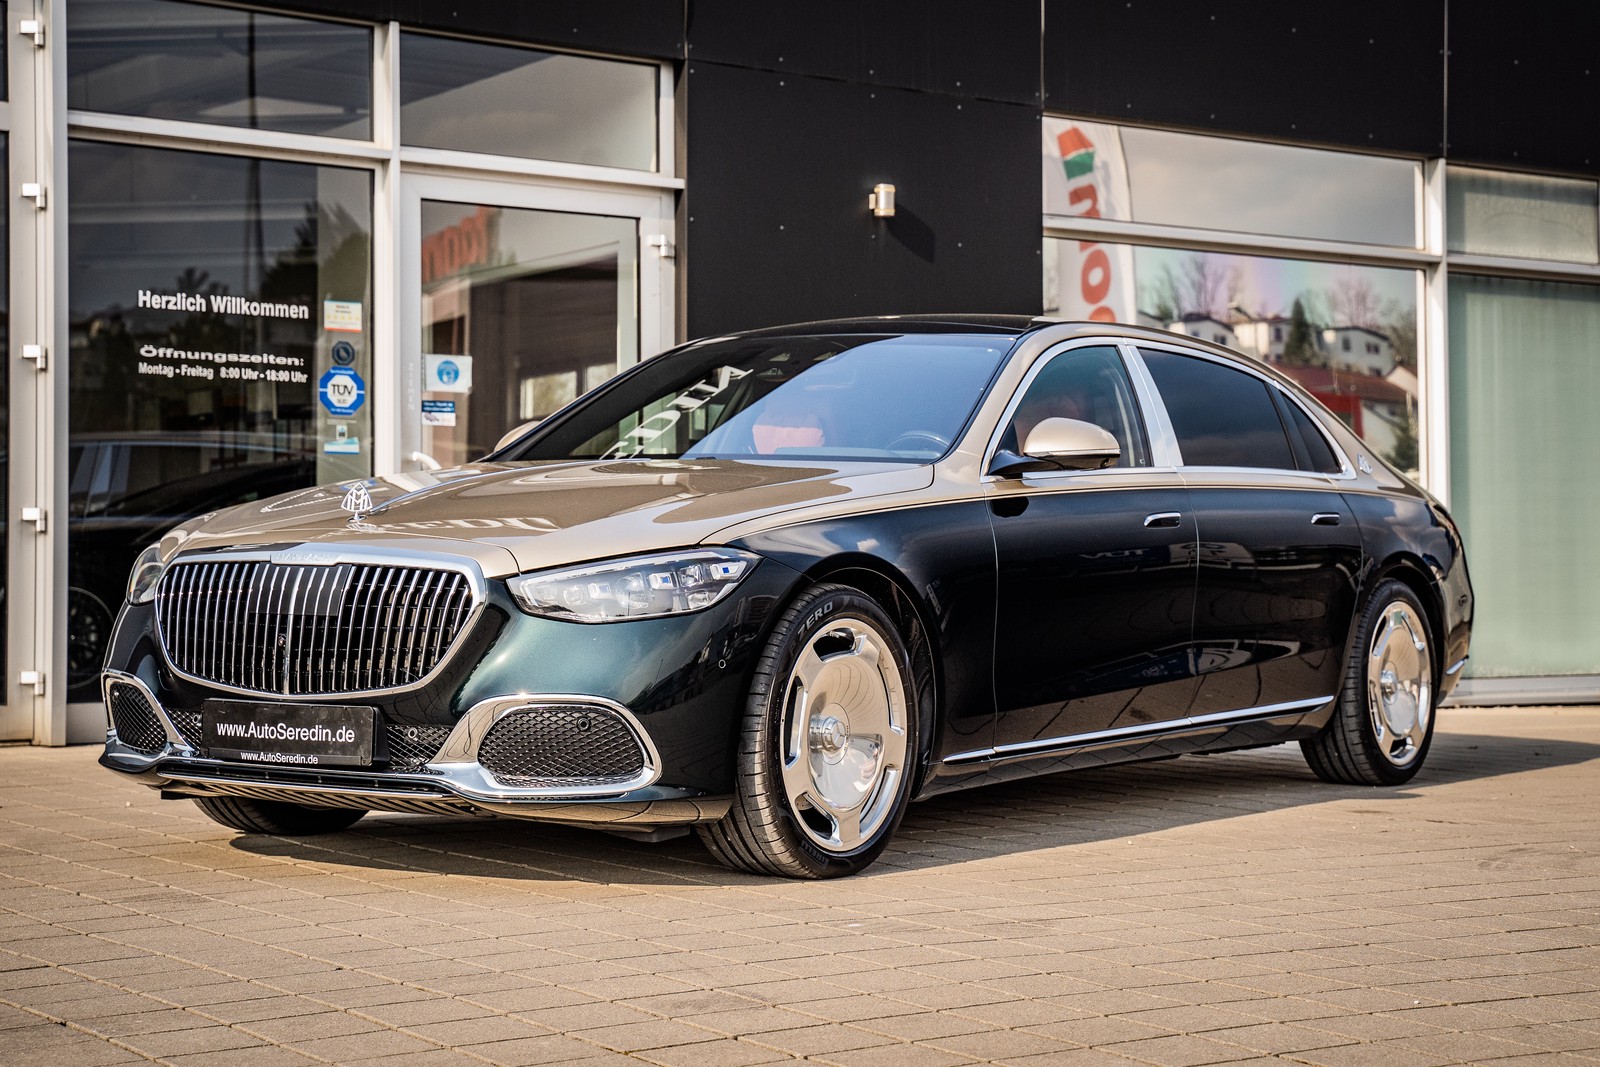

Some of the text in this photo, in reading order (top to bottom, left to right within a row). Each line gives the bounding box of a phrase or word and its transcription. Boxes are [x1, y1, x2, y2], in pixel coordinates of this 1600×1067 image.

[137, 289, 207, 312] Herzlich
[210, 295, 309, 320] Willkommen
[139, 344, 304, 366] Öffnungszeiten:
[138, 362, 174, 378] Montag
[181, 364, 214, 380] Freitag
[241, 368, 259, 381] Uhr
[265, 369, 290, 382] 18:00
[291, 370, 308, 383] Uhr
[797, 601, 833, 638] ZERO
[216, 721, 355, 743] www.AutoSeredin.de
[240, 751, 319, 765] www.AutoSeredin.de
